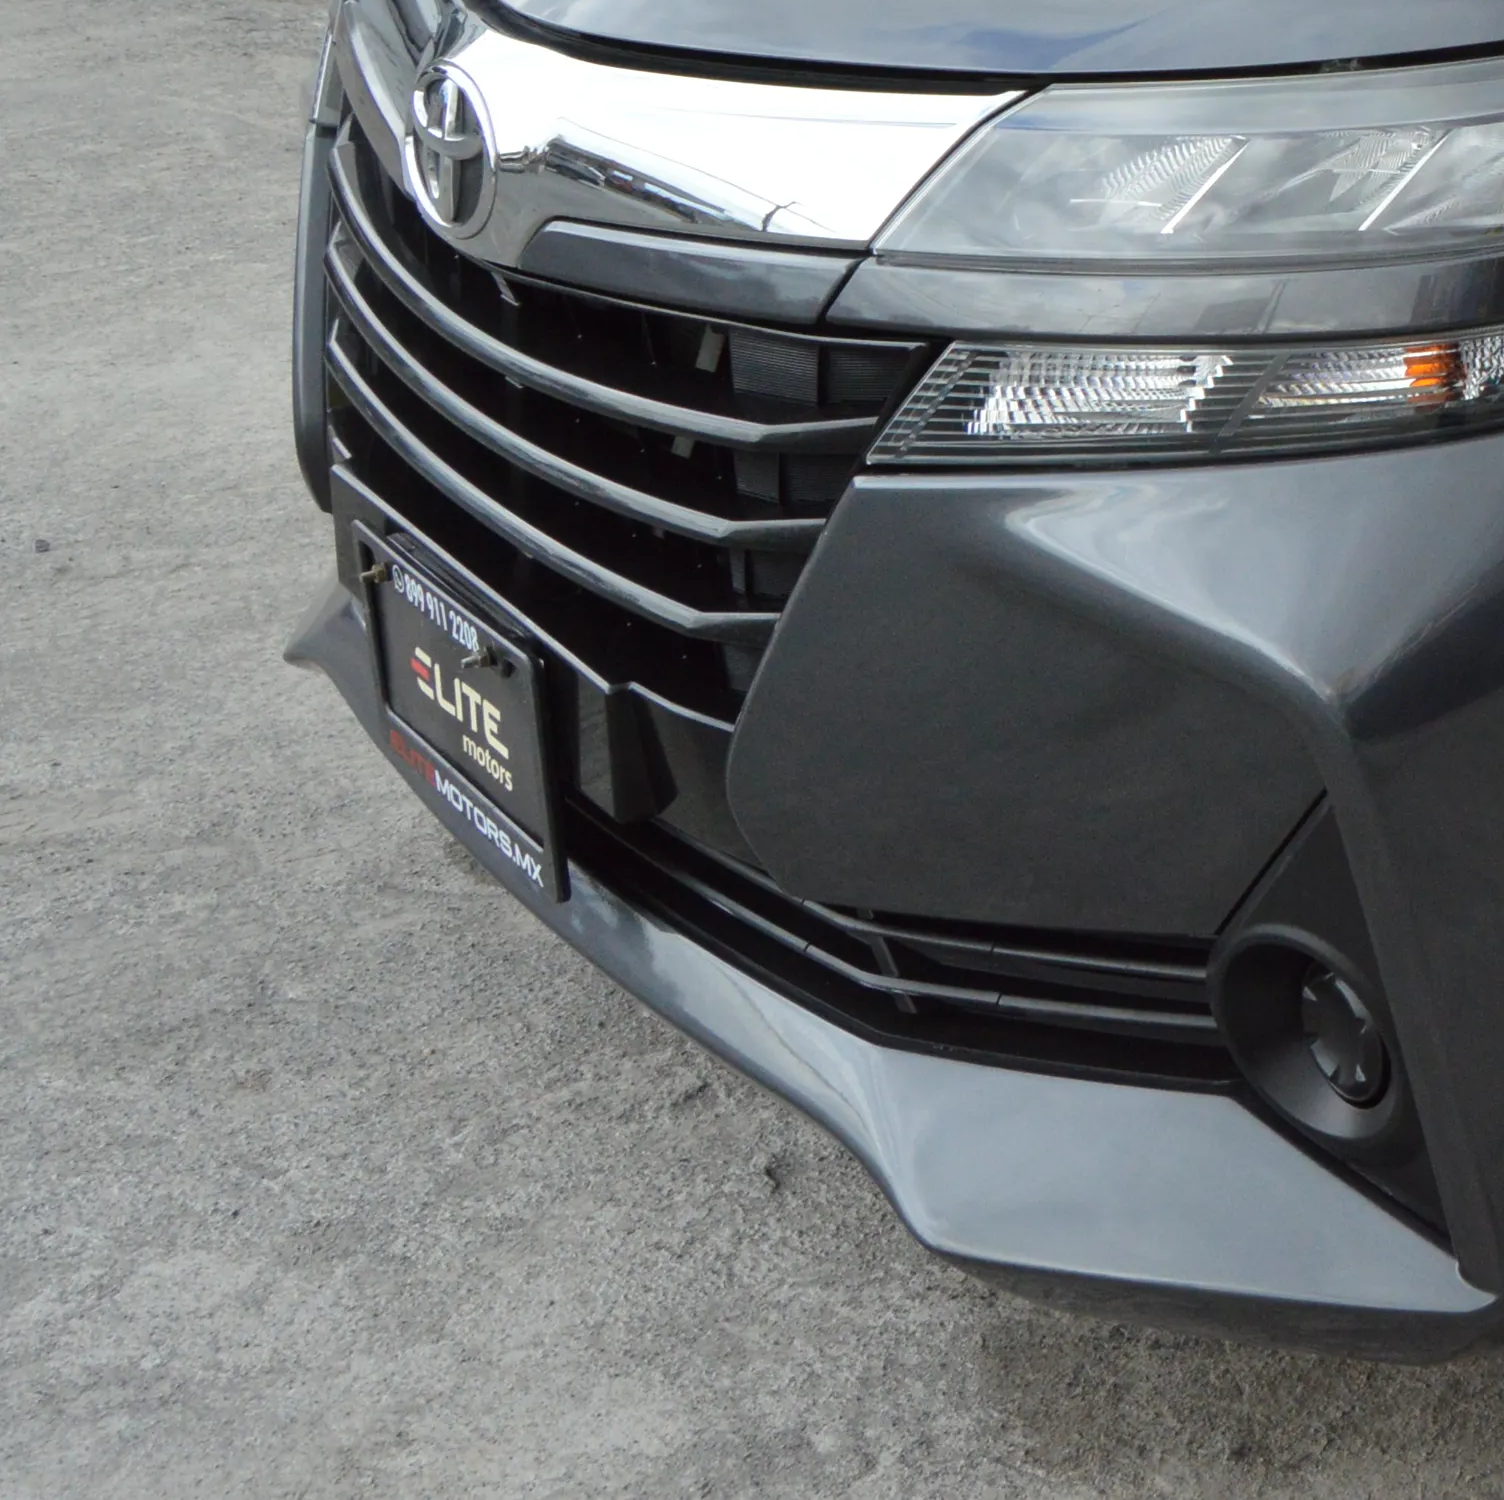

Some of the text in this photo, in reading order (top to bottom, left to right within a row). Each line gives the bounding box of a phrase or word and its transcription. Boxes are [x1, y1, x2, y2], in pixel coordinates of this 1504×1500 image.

[405, 575, 479, 652] 899 911 2208
[411, 647, 509, 760] ELITE
[390, 730, 544, 888] ELITEMOTORS.MX
[462, 734, 514, 792] motors
